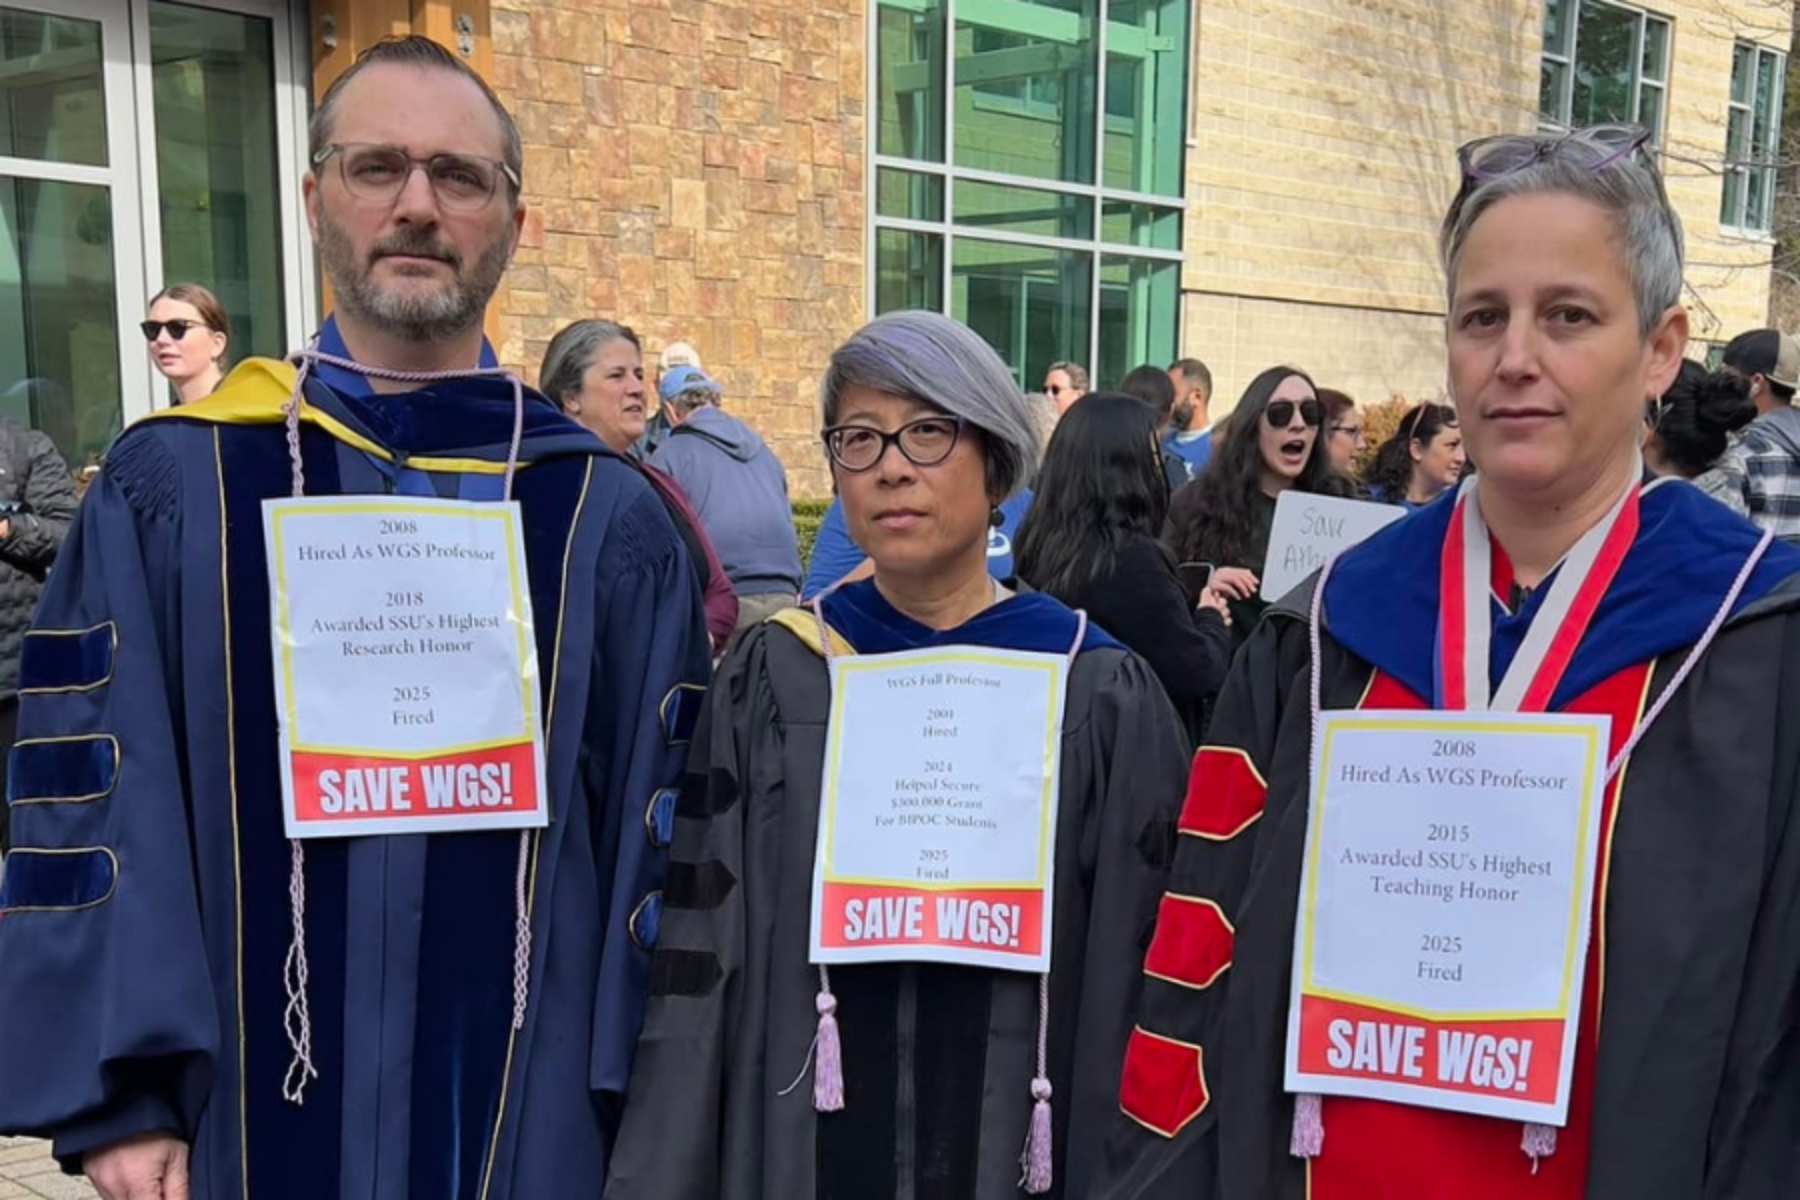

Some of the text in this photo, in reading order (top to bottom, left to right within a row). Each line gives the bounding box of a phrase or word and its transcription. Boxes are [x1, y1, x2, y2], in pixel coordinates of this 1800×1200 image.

[380, 520, 417, 534] 2008
[1300, 507, 1345, 538] Save
[299, 544, 495, 561] Hired As WGS Professor
[386, 592, 423, 607] 2018
[312, 615, 499, 633] Awarded SSU's Highest
[342, 639, 473, 656] Research Honor
[887, 674, 1001, 689] WGS Full Professor
[393, 687, 430, 701] 2025
[393, 710, 434, 725] Fired
[927, 709, 954, 721] 2001
[923, 726, 958, 738] Hired
[1432, 740, 1476, 758] 2008
[924, 761, 952, 773] 2024
[895, 779, 981, 793] Helped Secure
[1341, 765, 1568, 791] Hired As WGS Professor
[319, 762, 512, 814] SAVE WGS!
[947, 797, 983, 810] Grant
[875, 814, 997, 830] For BIPOC Students
[1428, 824, 1470, 841] 2015
[919, 849, 949, 861] 2025
[1340, 849, 1553, 877] Awarded SSU's Highest
[916, 867, 949, 880] Fired
[1370, 876, 1520, 902] Teaching Honor
[844, 896, 1020, 947] SAVE WGS!
[1420, 935, 1463, 952] 2025
[1418, 963, 1463, 982] Fired
[1327, 1019, 1533, 1093] SAVE WGS!
